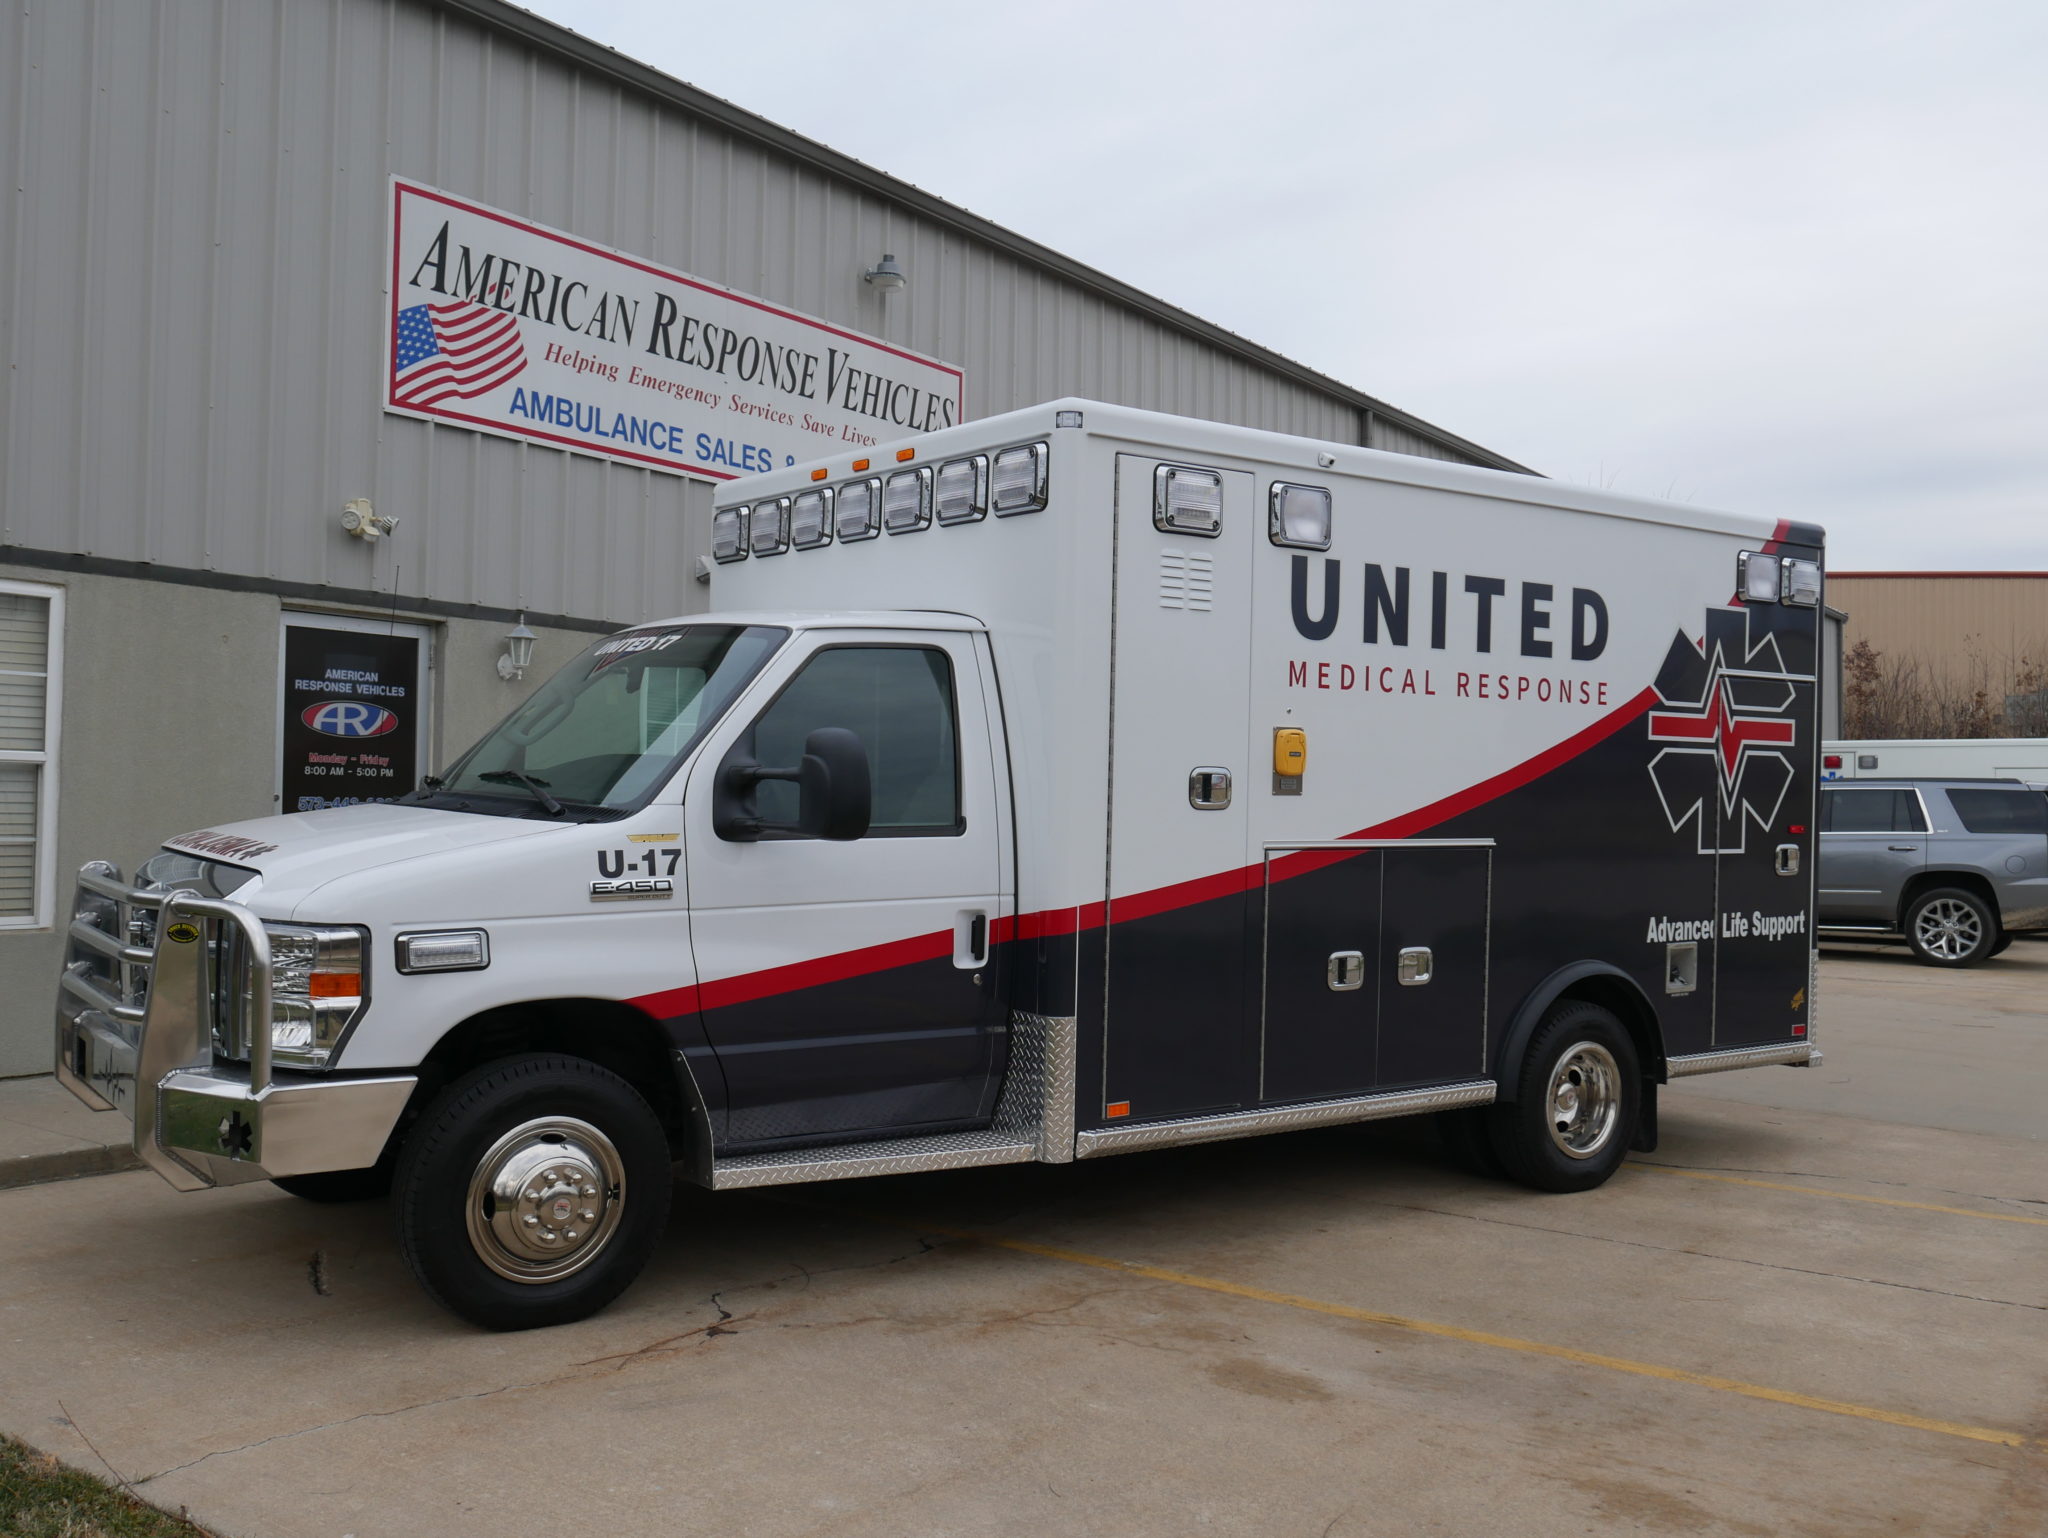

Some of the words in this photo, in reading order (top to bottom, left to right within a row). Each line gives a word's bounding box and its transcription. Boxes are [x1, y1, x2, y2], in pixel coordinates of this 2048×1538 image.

[408, 220, 640, 347] AMERICAN
[645, 291, 819, 399] RESPONSE
[826, 347, 955, 433] VEHICLES
[544, 342, 619, 382] Helping
[627, 366, 721, 409] Emergency
[728, 394, 794, 426] Services
[800, 413, 835, 437] Save
[841, 424, 877, 447] Lives
[509, 387, 684, 454] AMBULANCE
[695, 432, 773, 473] SALES
[1290, 554, 1609, 661] UNITED
[295, 679, 353, 693] RESPONSE
[356, 684, 405, 697] VEHICLES
[325, 668, 379, 682] AMERICAN
[1288, 660, 1436, 696] MEDICAL
[1457, 672, 1608, 706] RESPONSE
[304, 766, 326, 776] 8:00
[329, 767, 344, 776] AM
[356, 767, 377, 777] 5:00
[380, 768, 393, 777] PM
[308, 752, 348, 765] Monday
[359, 754, 390, 767] Friday
[597, 848, 682, 879] U-17
[1722, 911, 1749, 938] Life
[1752, 909, 1805, 941] Support
